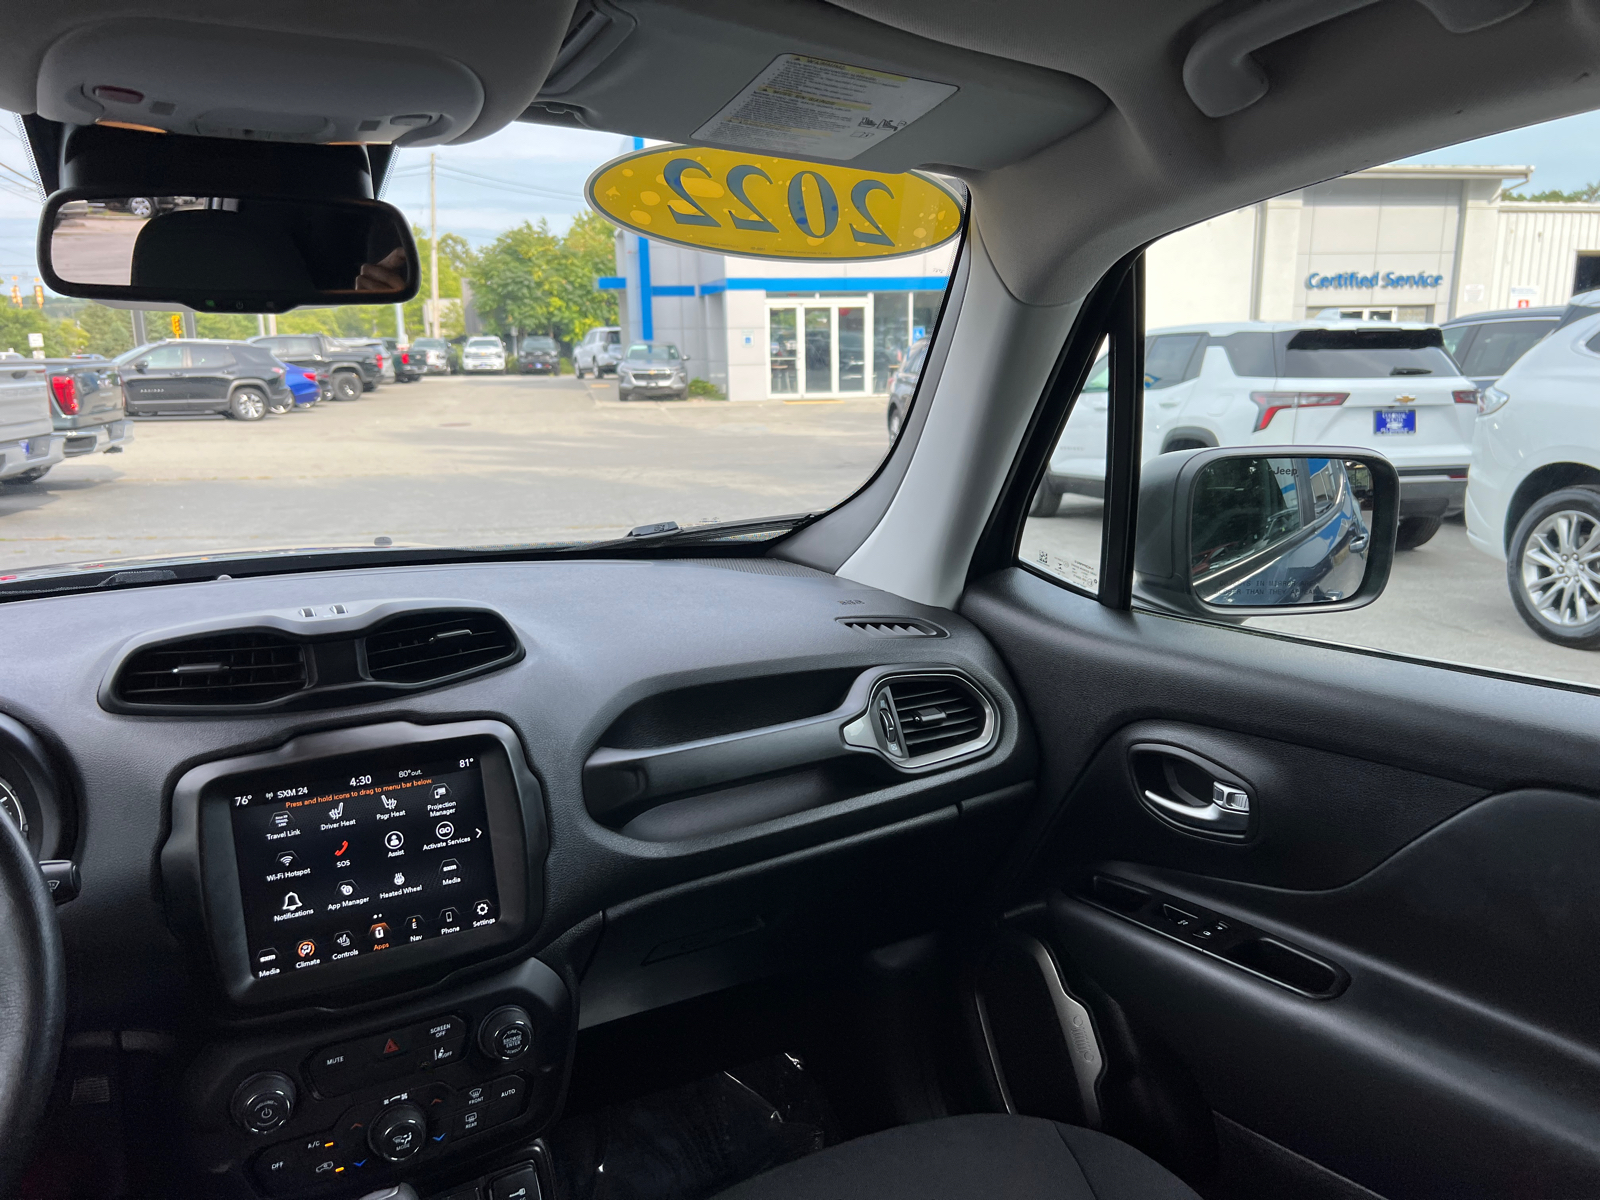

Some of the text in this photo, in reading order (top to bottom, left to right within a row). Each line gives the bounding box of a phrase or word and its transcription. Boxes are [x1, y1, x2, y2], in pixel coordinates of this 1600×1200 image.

[1307, 271, 1443, 289] Certified Service
[1274, 466, 1298, 477] Jeep
[459, 757, 474, 768] 81°
[350, 775, 372, 787] 4:30
[235, 787, 309, 807] 76° SXM 24
[304, 797, 317, 805] and
[318, 795, 333, 803] hold
[333, 792, 350, 801] icons
[359, 786, 374, 796] drag
[383, 783, 401, 792] menu
[402, 781, 412, 789] bar
[427, 800, 457, 811] Projection
[376, 809, 406, 821] Psgr Heat
[429, 808, 456, 818] Manager
[320, 819, 356, 831] Driver Heat
[266, 828, 301, 840] Travel Link
[423, 836, 471, 851] Activate Services
[387, 849, 405, 858] Assist
[336, 859, 351, 868] SOS
[266, 867, 311, 882] Wi-Fi Hotspot
[442, 877, 461, 886] Media
[380, 884, 423, 899] Heated Wheel
[327, 897, 370, 911] App Manager
[274, 908, 314, 922] Notifications
[472, 917, 496, 928] Settings
[441, 925, 460, 935] Phone
[410, 934, 423, 943] Nav
[373, 942, 390, 951] Apps
[332, 949, 359, 960] Controls
[295, 959, 321, 969] Climate
[258, 967, 281, 978] Media
[430, 1022, 451, 1035] SCREEN
[435, 1030, 446, 1038] OFF
[326, 1055, 345, 1066] MUTE
[501, 1088, 516, 1097] AUTO
[468, 1096, 484, 1105] FRONT
[307, 1140, 321, 1149] A/C
[271, 1161, 284, 1171] OFF
